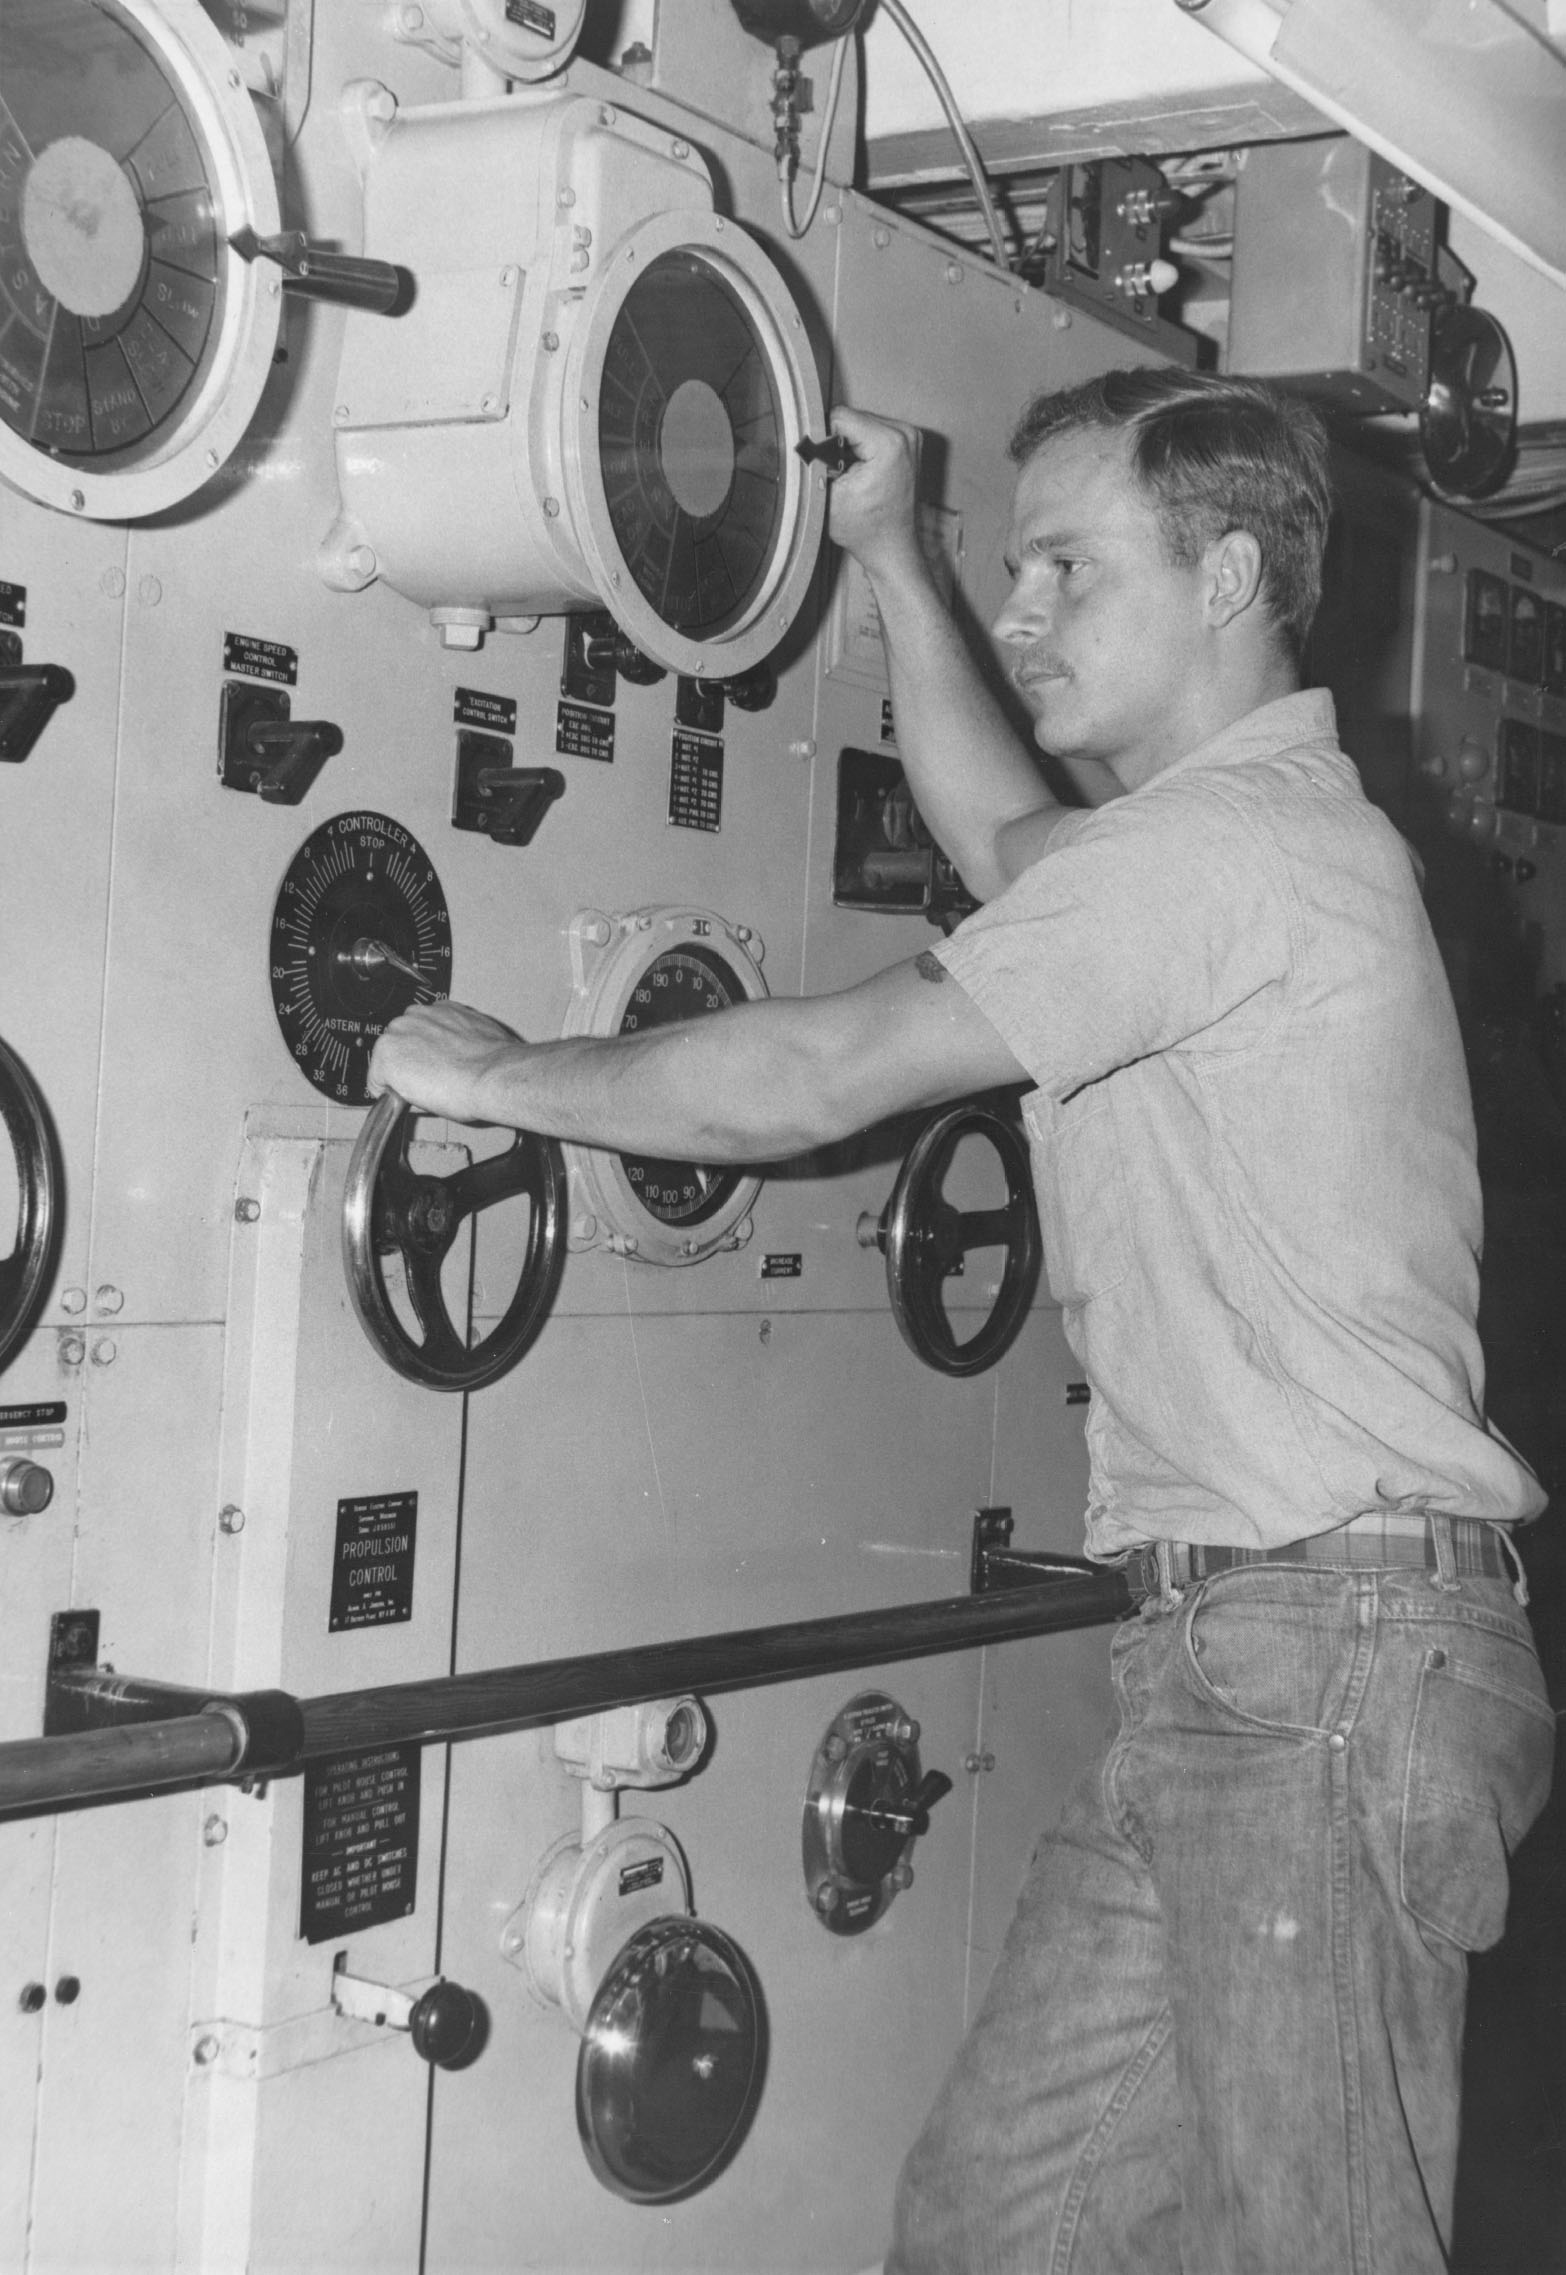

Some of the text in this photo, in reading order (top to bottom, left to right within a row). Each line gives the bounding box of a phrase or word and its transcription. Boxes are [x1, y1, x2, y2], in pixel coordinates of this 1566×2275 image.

[234, 636, 287, 657] ENGINE SPEED
[243, 651, 278, 667] CONTROL
[230, 660, 288, 682] MASTER SWITCH
[462, 707, 486, 720] CONTROL
[338, 815, 408, 849] CONTROLLER
[359, 835, 385, 849] STOP
[410, 843, 417, 855] 4
[304, 846, 311, 858] 8
[427, 870, 434, 882] 8
[284, 881, 295, 894] 12
[275, 916, 286, 930] 16
[437, 909, 447, 923] 12
[440, 945, 451, 958] 16
[272, 967, 285, 979] 20
[652, 972, 669, 988] 190
[675, 968, 683, 983] 0
[692, 976, 703, 991] 10
[436, 991, 447, 1001] 20
[635, 988, 651, 1004] 180
[706, 994, 719, 1008] 20
[278, 1002, 291, 1015] 24
[324, 1018, 389, 1037] ASTERN AHEA
[624, 1014, 638, 1029] 70
[295, 1042, 308, 1056] 28
[313, 1069, 326, 1082] 32
[335, 1083, 348, 1096] 36
[627, 1167, 644, 1181] 120
[645, 1184, 659, 1199] 110
[662, 1190, 678, 1204] 100
[683, 1186, 695, 1200] 90
[343, 1535, 408, 1560] PROPULSION
[349, 1564, 398, 1588] CONTROL
[356, 1775, 375, 1788] HOUSE
[381, 1767, 408, 1782] CONTROL
[360, 1788, 373, 1800] AND
[377, 1783, 394, 1796] PUSH
[372, 1801, 399, 1818] CONTROL
[357, 1822, 370, 1834] AND
[375, 1817, 389, 1831] PULL
[311, 1869, 329, 1883] KEEP
[346, 1860, 360, 1872] AND
[345, 1901, 372, 1918] CONTROL
